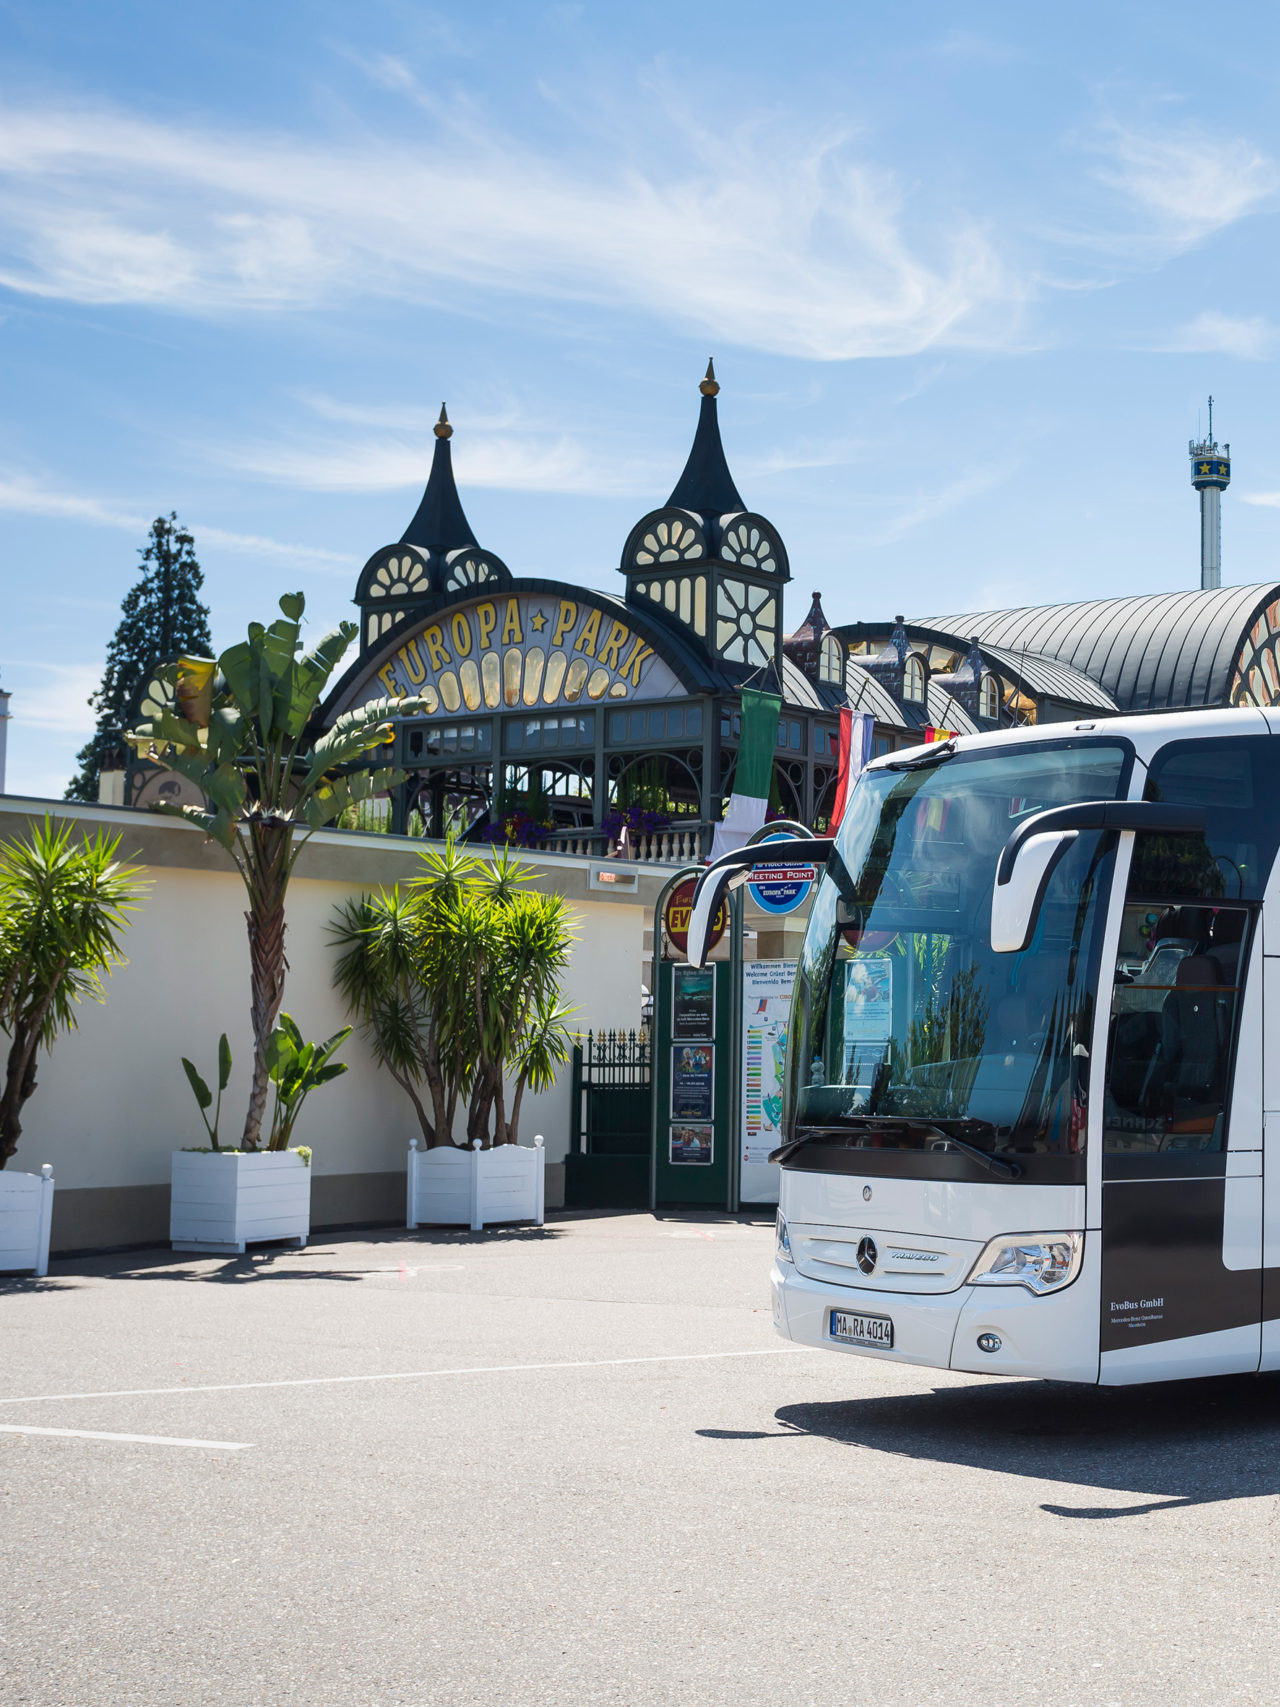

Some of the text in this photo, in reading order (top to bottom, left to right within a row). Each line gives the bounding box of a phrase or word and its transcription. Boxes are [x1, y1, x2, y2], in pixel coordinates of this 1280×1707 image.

[378, 598, 656, 699] EUROPA PARK
[787, 871, 813, 879] POINT
[1110, 1298, 1164, 1311] EvoBus GmbH
[836, 1315, 890, 1341] MA RA 4014
